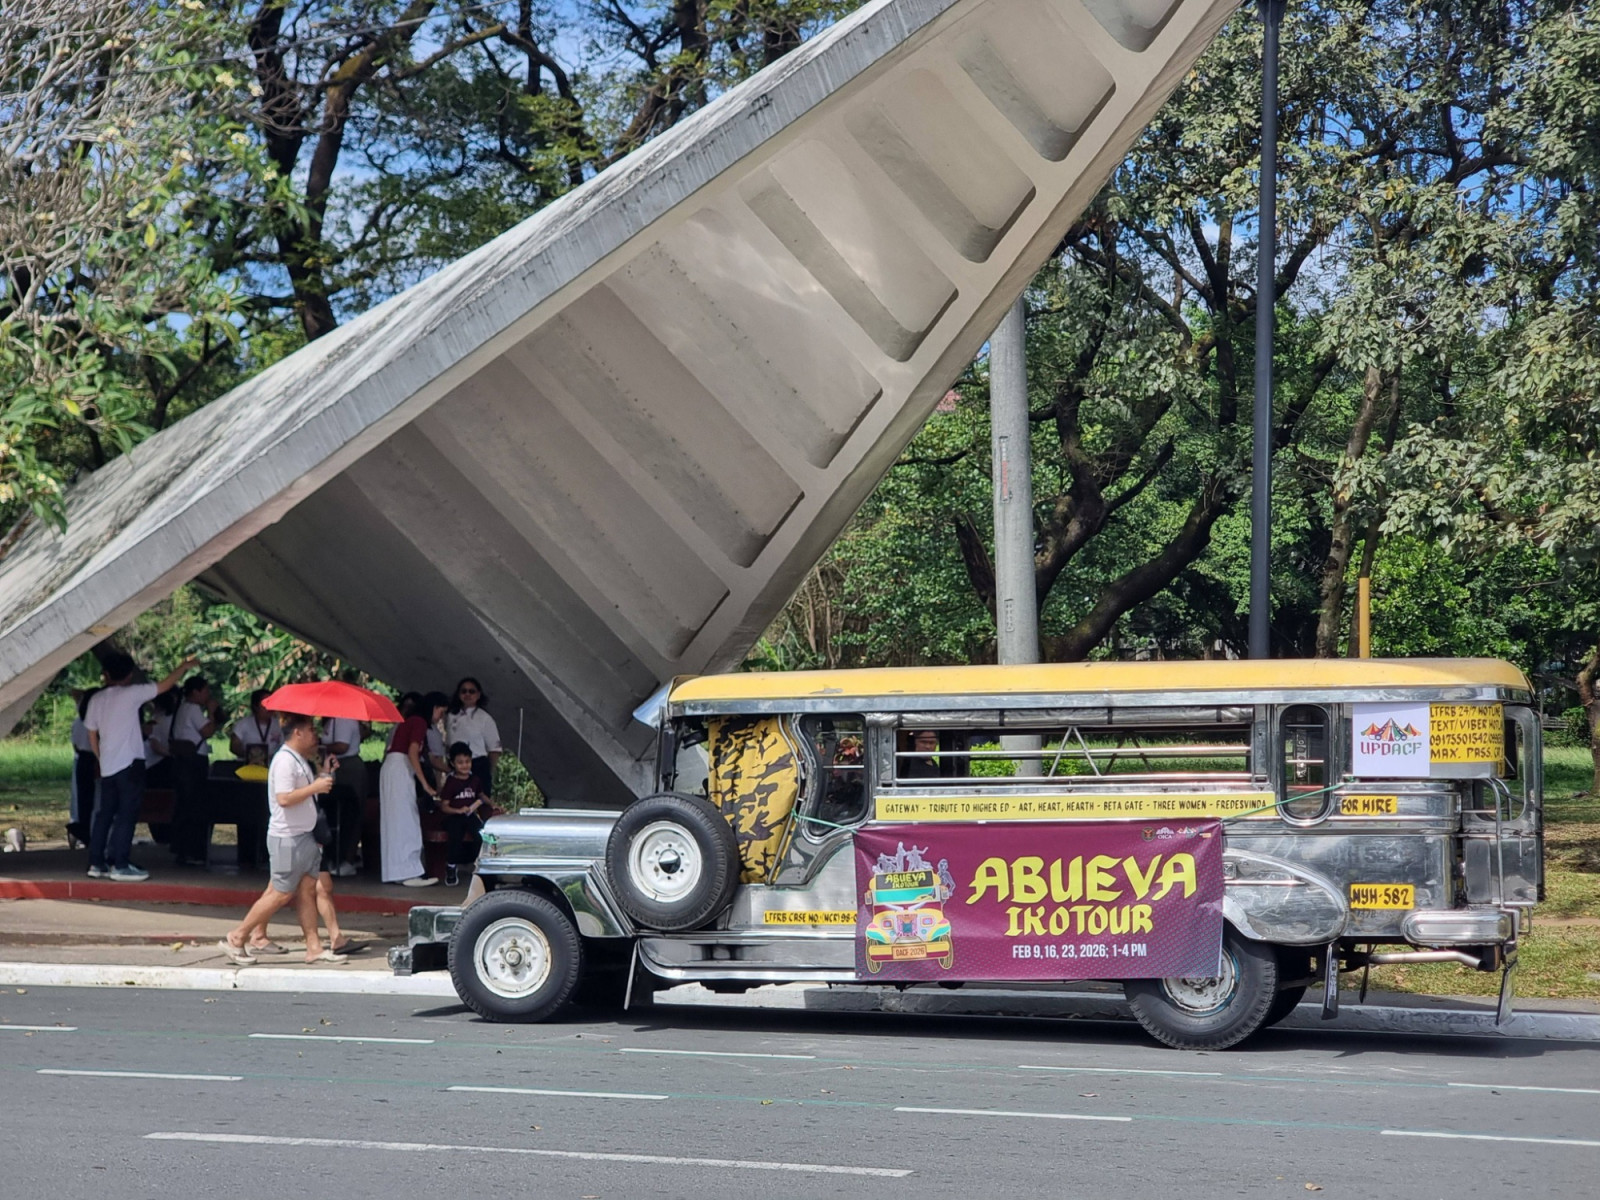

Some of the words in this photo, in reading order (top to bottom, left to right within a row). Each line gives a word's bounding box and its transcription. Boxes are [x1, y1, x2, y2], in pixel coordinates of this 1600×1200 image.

[1430, 707, 1456, 718] LTFRB
[1459, 706, 1476, 717] 24/7
[1360, 741, 1422, 756] UPDACF
[1431, 748, 1461, 760] MAX.
[885, 804, 919, 813] GATEWAY
[929, 804, 957, 813] TRIBUTE
[961, 804, 970, 812] TO
[973, 803, 997, 812] HIGHER
[1000, 803, 1009, 812] ED
[1018, 803, 1036, 813] ART,
[1038, 802, 1064, 812] HEART,
[1066, 802, 1094, 811] HEARTH
[1103, 801, 1122, 810] BETA
[1124, 801, 1143, 810] GATE
[1153, 801, 1175, 810] THREE
[1179, 800, 1207, 809] WOMEN
[1216, 799, 1267, 809] FREDESVINDA
[1341, 799, 1358, 812] FOR
[1362, 799, 1392, 812] HIRE
[885, 872, 926, 884] ABUEVA
[966, 853, 1198, 905] ABUEVA
[1352, 887, 1409, 906] NYH-582
[789, 913, 806, 922] CASE
[1005, 904, 1154, 937] IKOTOUR
[1012, 945, 1032, 958] FEB
[1061, 945, 1078, 959] 23,
[1080, 944, 1108, 958] 2026;
[1112, 944, 1129, 957] 1-4
[1131, 944, 1147, 957] PM
